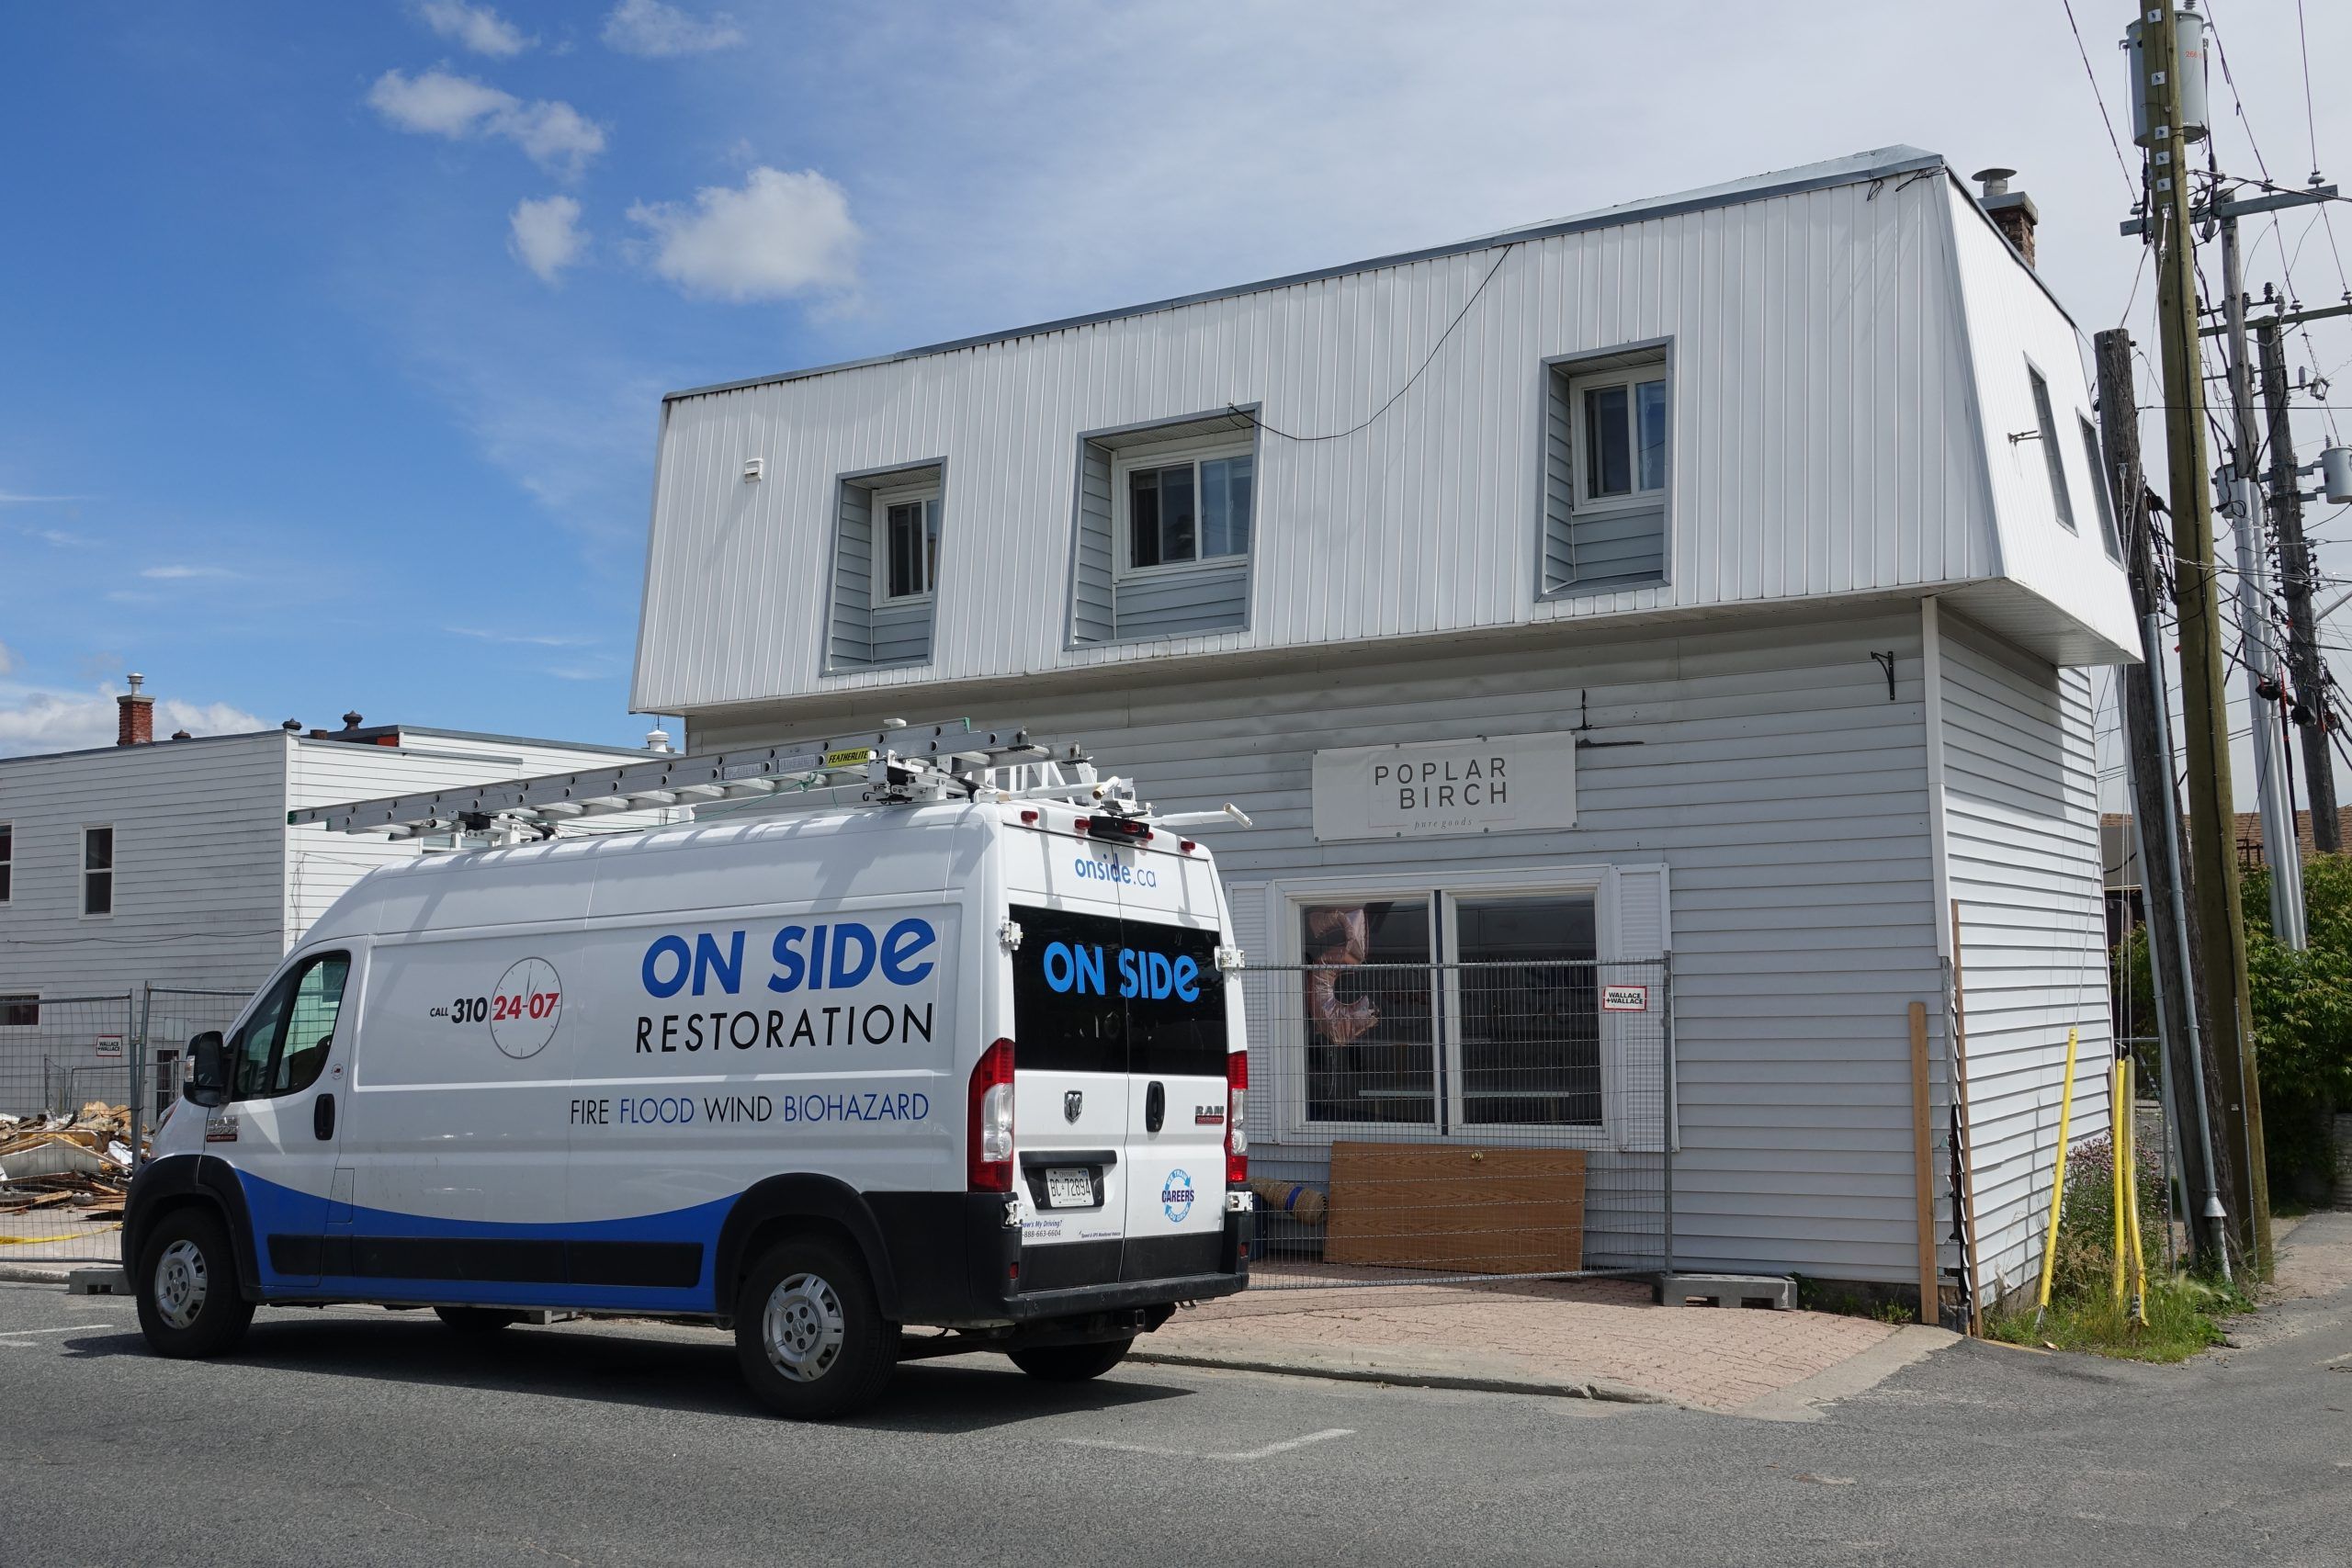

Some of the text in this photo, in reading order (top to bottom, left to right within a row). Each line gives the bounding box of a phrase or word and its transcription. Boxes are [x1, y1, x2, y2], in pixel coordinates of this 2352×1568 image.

[828, 750, 868, 763] FEATHERLITE
[1374, 757, 1507, 785] POPLAR
[1399, 782, 1507, 809] BIRCH
[1441, 817, 1472, 829] goods
[1075, 852, 1157, 887] onside.ca
[642, 931, 746, 998] ON
[1043, 942, 1105, 995] ON
[430, 992, 560, 1023] CALL 310 24-07
[636, 1003, 933, 1054] RESTORATION
[571, 1093, 929, 1124] FIRE FLOOD WIND BIOHAZARD
[1195, 1106, 1224, 1114] RAM
[1050, 1178, 1061, 1197] BC
[1161, 1190, 1194, 1203] CAREERS
[1022, 1229, 1061, 1238] -888-663-6604
[1044, 1220, 1063, 1229] Driving?
